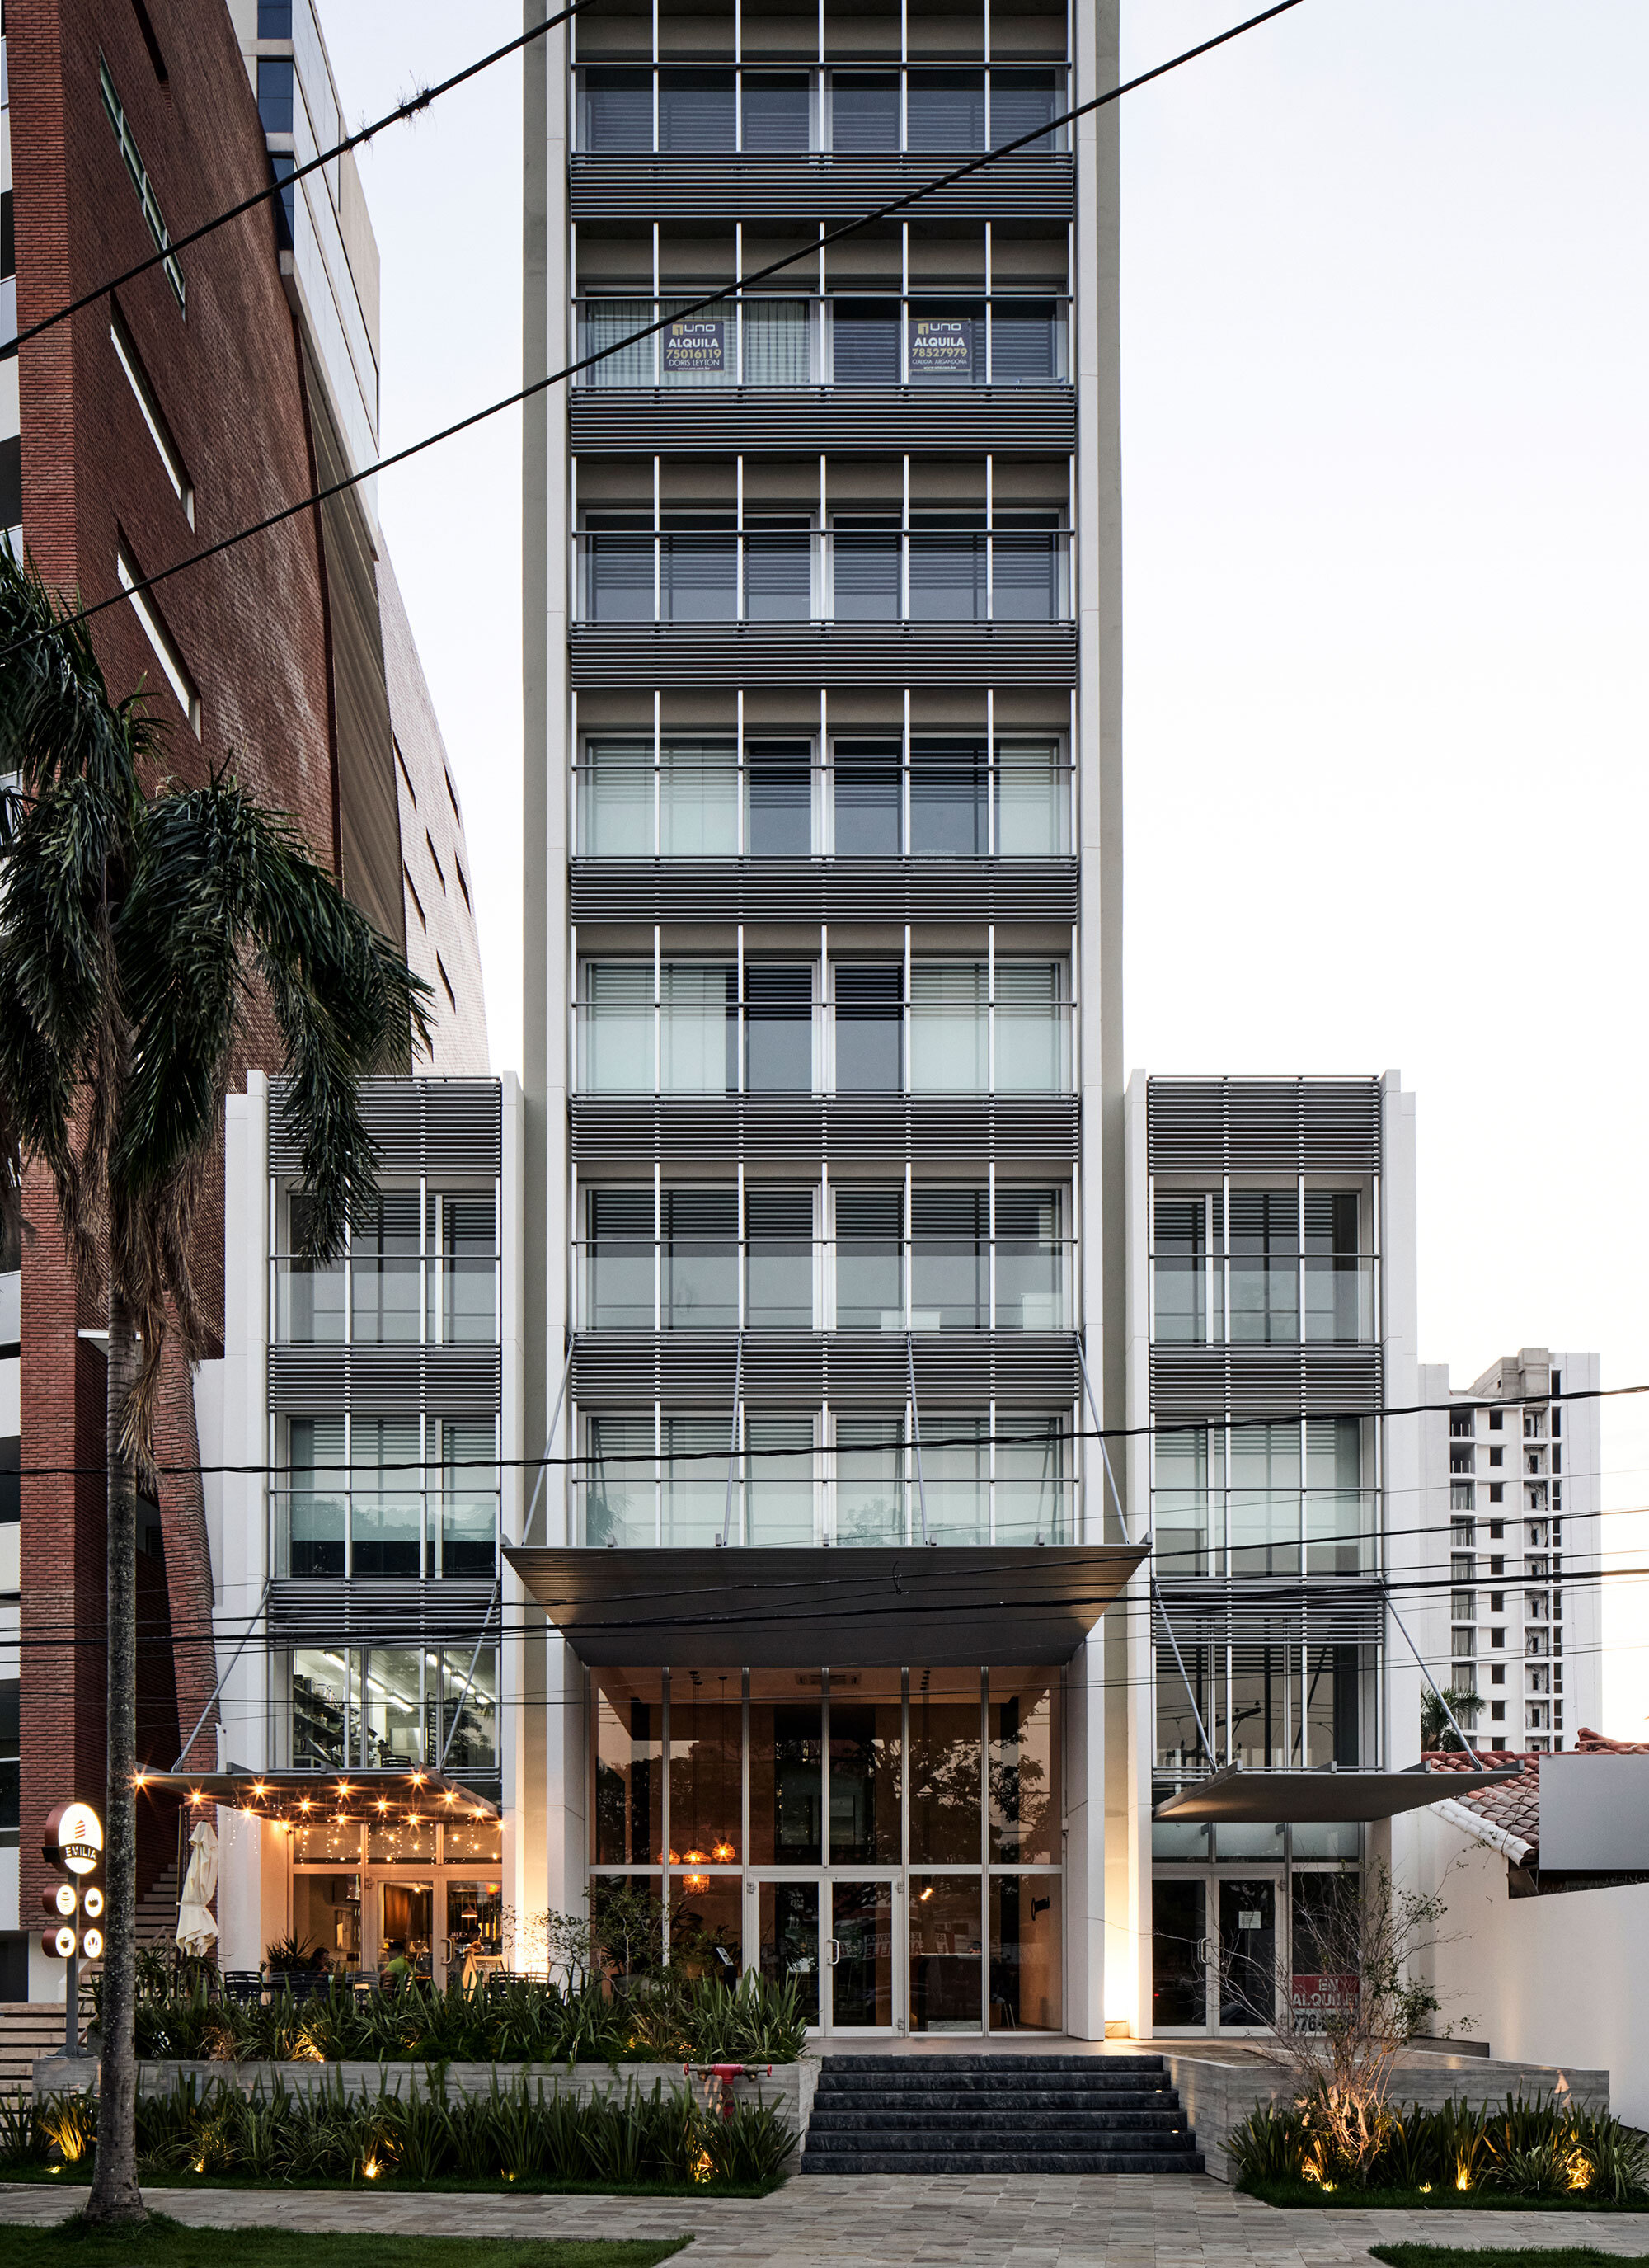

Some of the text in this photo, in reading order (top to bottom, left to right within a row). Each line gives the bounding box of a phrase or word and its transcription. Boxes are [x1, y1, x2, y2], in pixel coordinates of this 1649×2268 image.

[668, 338, 719, 348] ALQUILA
[914, 337, 965, 347] ALQUILA
[666, 349, 721, 359] 75016119
[912, 348, 968, 357] 78527979
[65, 1846, 96, 1860] EMILIA
[1318, 1978, 1339, 1992] EN
